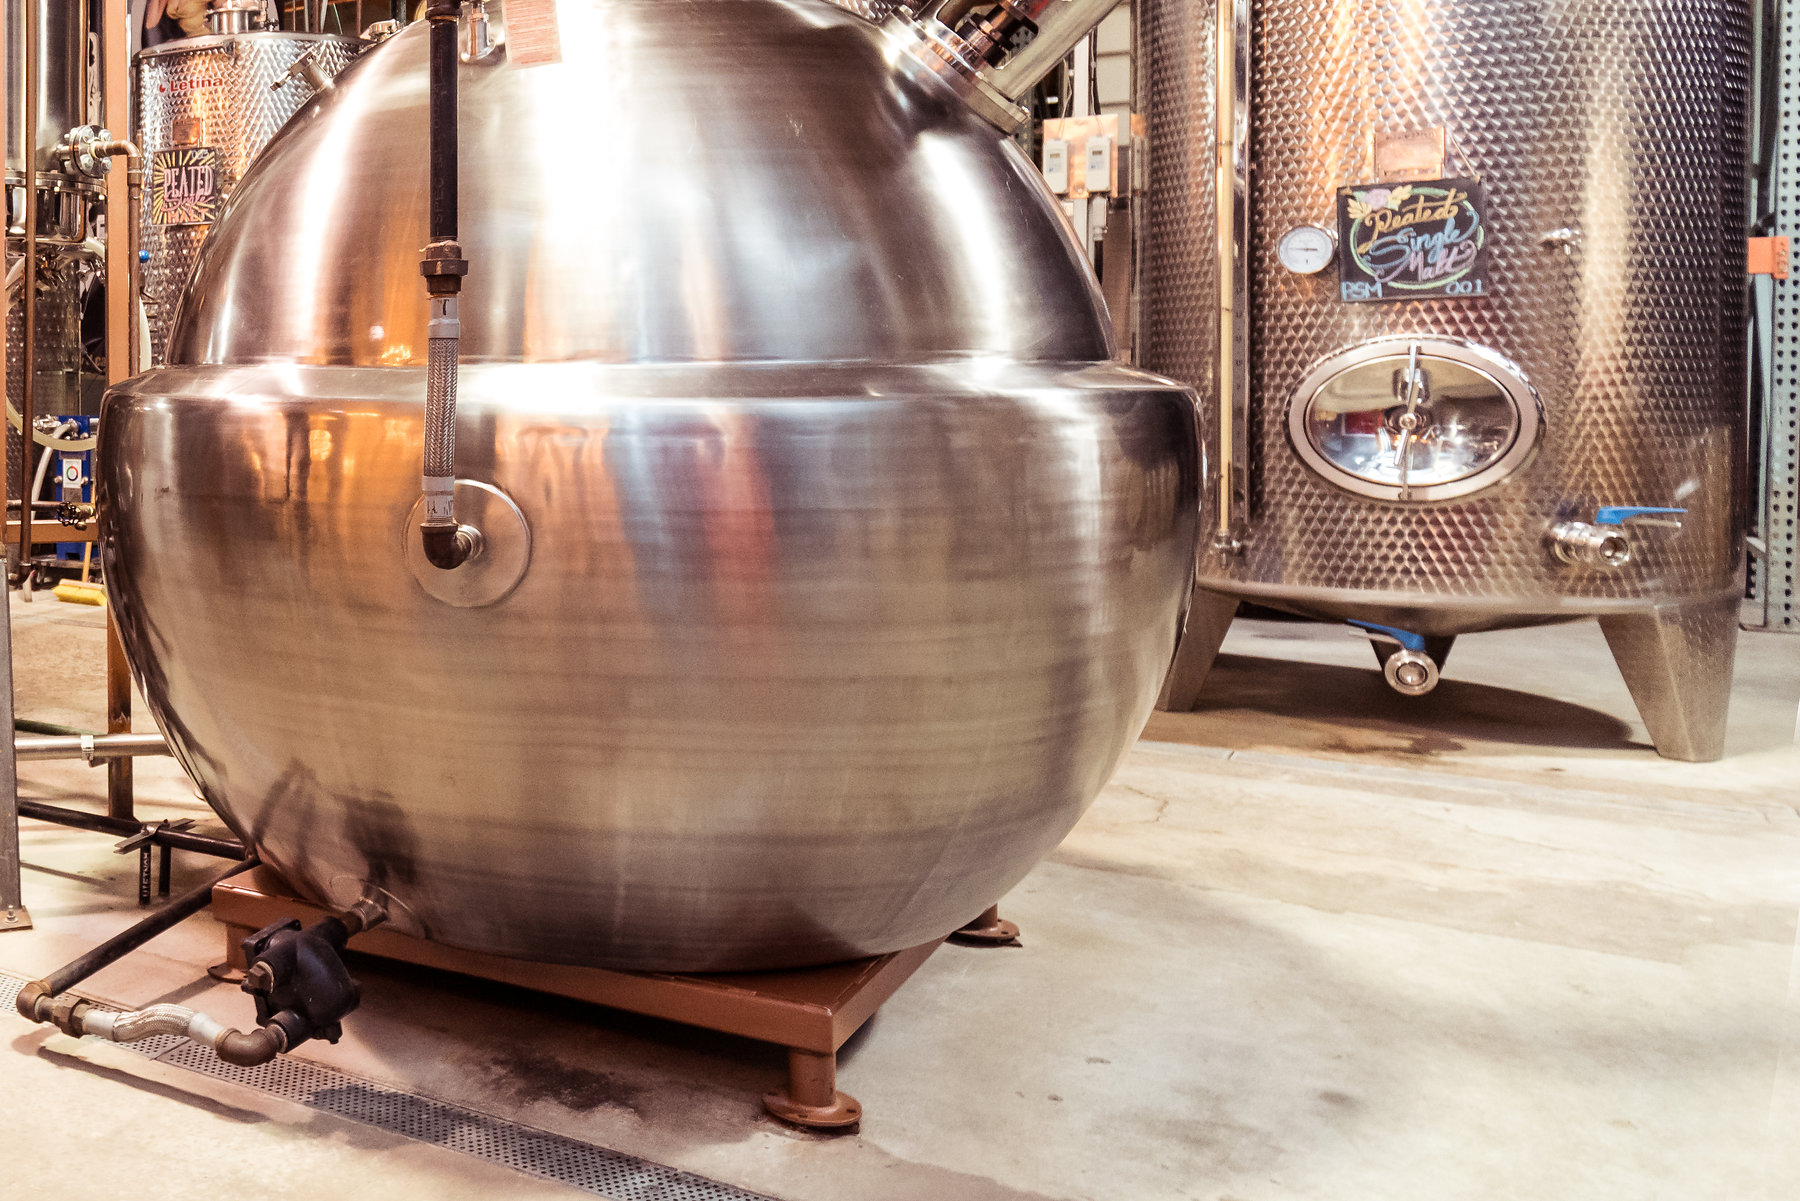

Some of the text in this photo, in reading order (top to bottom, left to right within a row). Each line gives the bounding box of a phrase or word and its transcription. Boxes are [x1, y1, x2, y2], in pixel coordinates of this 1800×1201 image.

[170, 75, 224, 93] Letina
[163, 165, 214, 198] PEATED
[161, 189, 215, 212] Single
[167, 207, 209, 223] MALT
[1357, 188, 1468, 254] Peated
[1363, 211, 1480, 268] Single
[1375, 239, 1479, 282] Malt
[1444, 278, 1484, 295] 001
